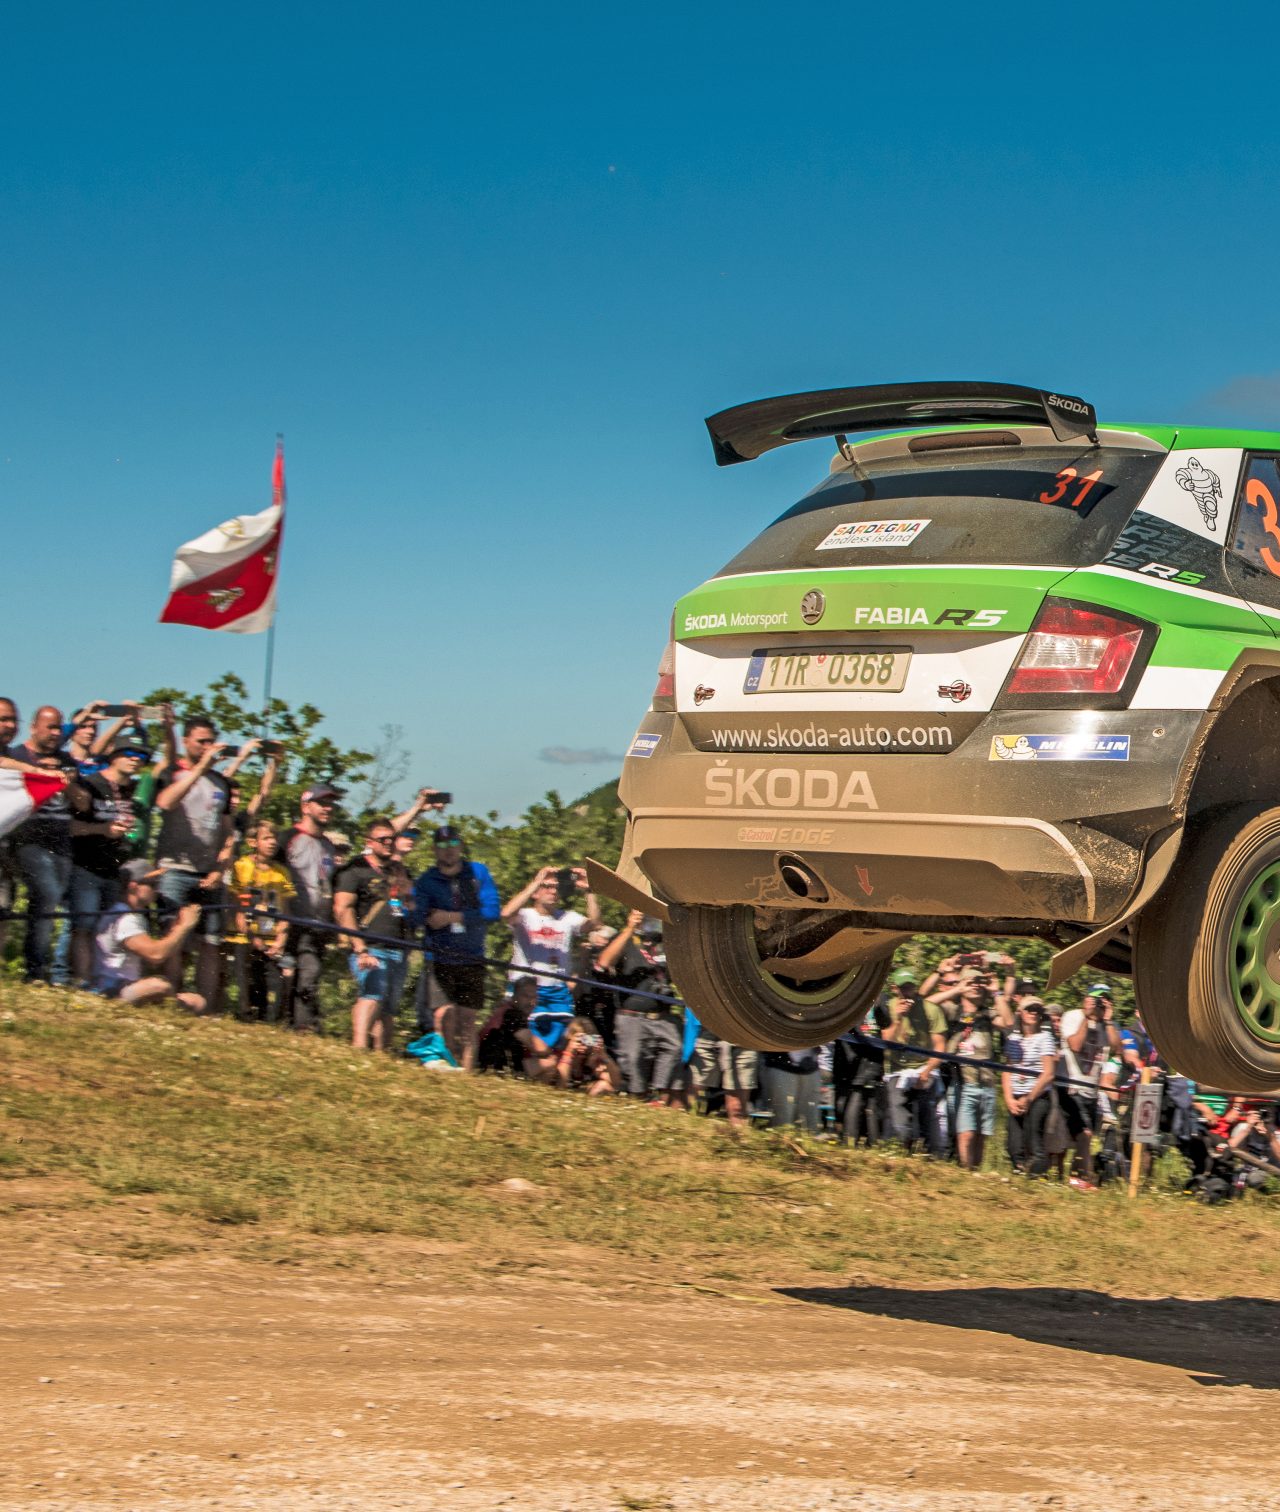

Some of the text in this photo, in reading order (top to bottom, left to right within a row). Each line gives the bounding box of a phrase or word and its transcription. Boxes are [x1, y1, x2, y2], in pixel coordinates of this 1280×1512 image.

[1048, 395, 1089, 416] ŠKODA
[1040, 467, 1103, 507] 31
[824, 532, 913, 546] endless island
[833, 522, 922, 537] SARDEGNA
[1138, 562, 1207, 585] R5
[685, 611, 788, 631] ŠKODA Motorsport
[854, 607, 1009, 627] FABIA R5
[770, 652, 895, 687] 11R 0368
[747, 676, 759, 687] CZ
[711, 722, 953, 748] www.skoda-auto.com
[704, 759, 880, 810] ŠKODA
[779, 827, 836, 846] EDGE
